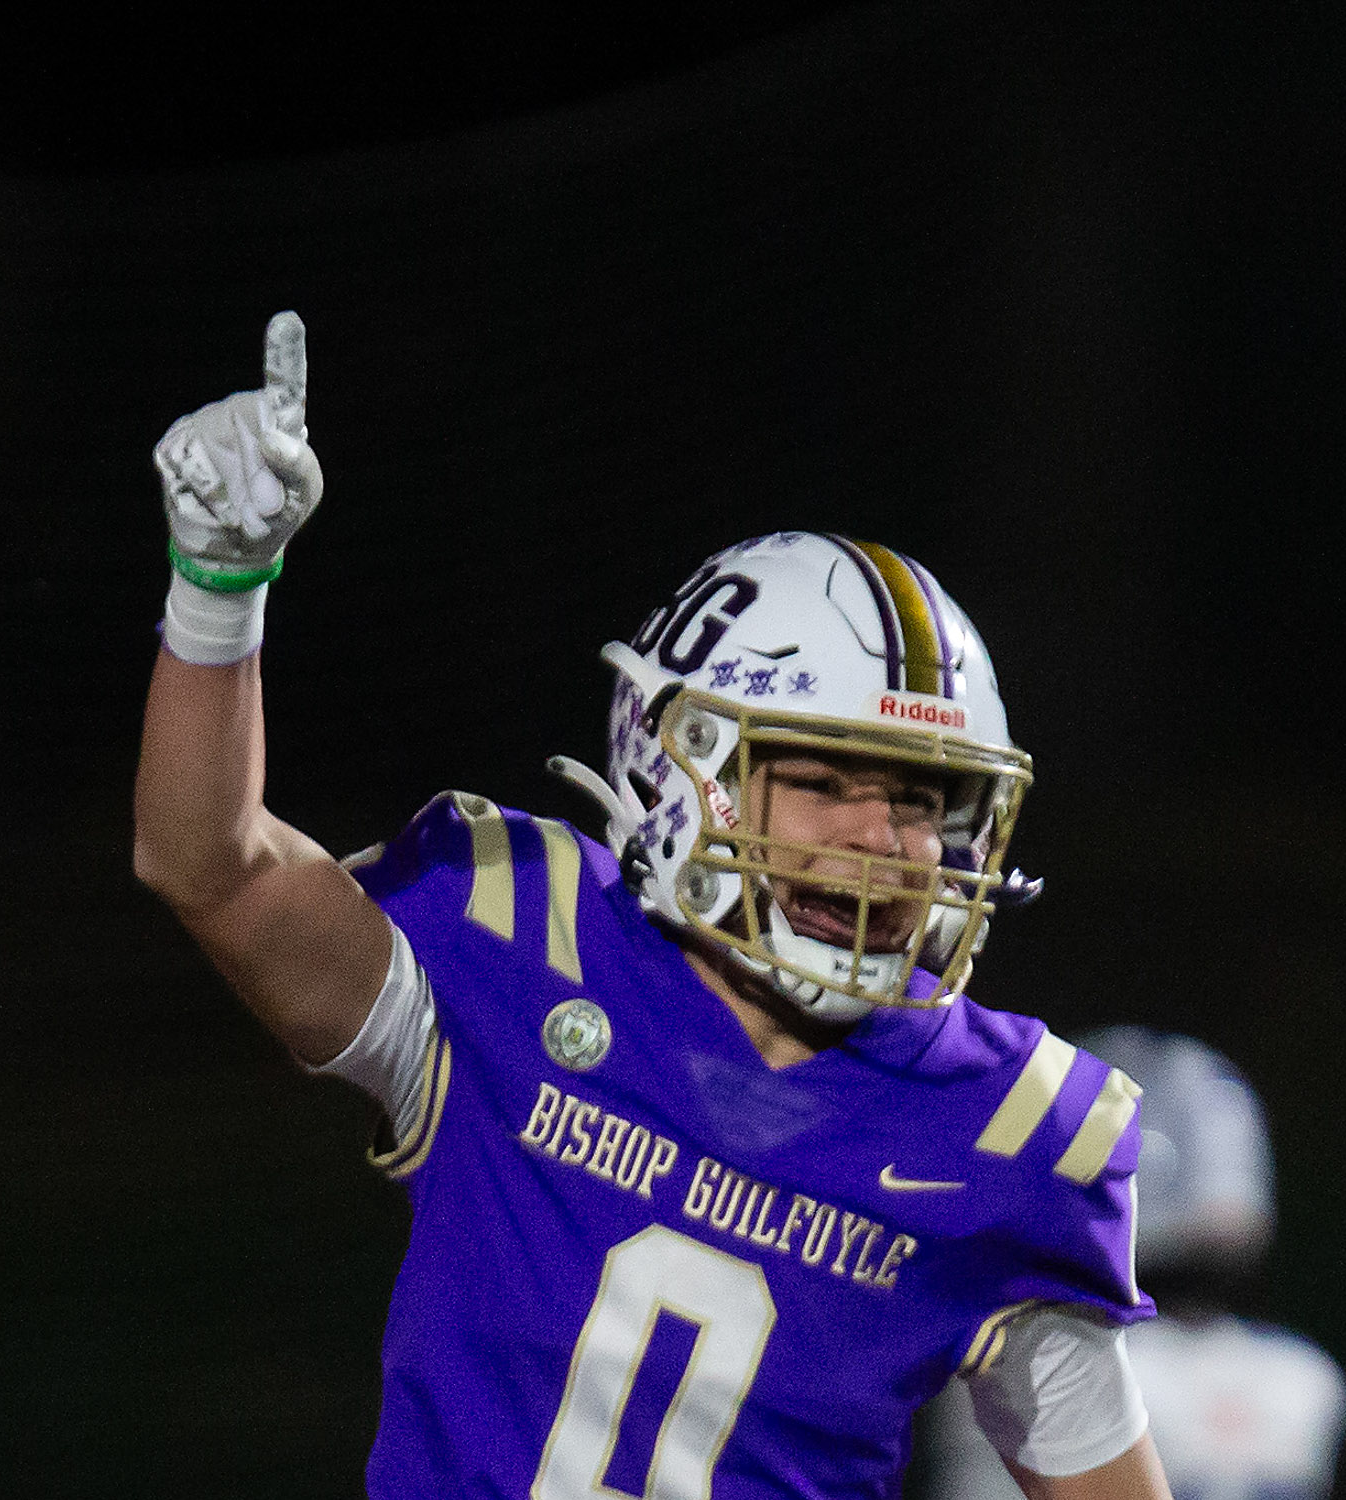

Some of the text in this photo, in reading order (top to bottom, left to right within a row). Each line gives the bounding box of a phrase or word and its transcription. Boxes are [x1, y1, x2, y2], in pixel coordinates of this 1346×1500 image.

[880, 696, 965, 728] Riddell
[517, 1082, 919, 1288] BISHOP GUILFOYLE
